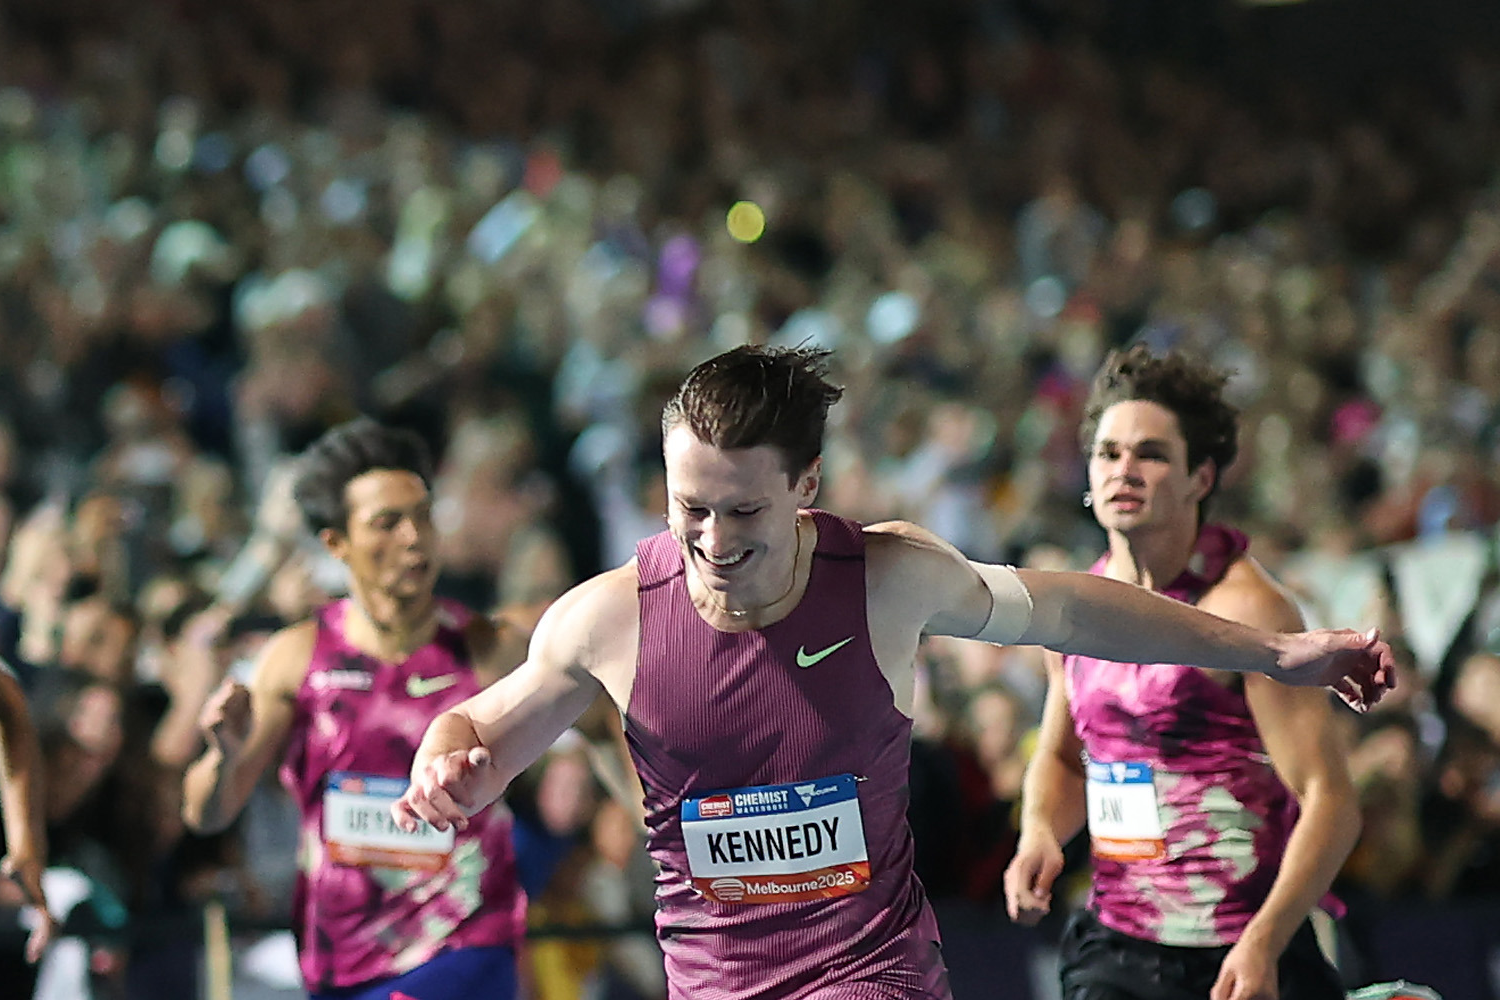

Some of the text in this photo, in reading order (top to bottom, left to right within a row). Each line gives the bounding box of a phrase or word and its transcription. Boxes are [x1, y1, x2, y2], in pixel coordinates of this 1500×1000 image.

[735, 791, 788, 807] CHEMIST
[707, 817, 839, 864] KENNEDY
[746, 871, 855, 895] Melbourne2025
